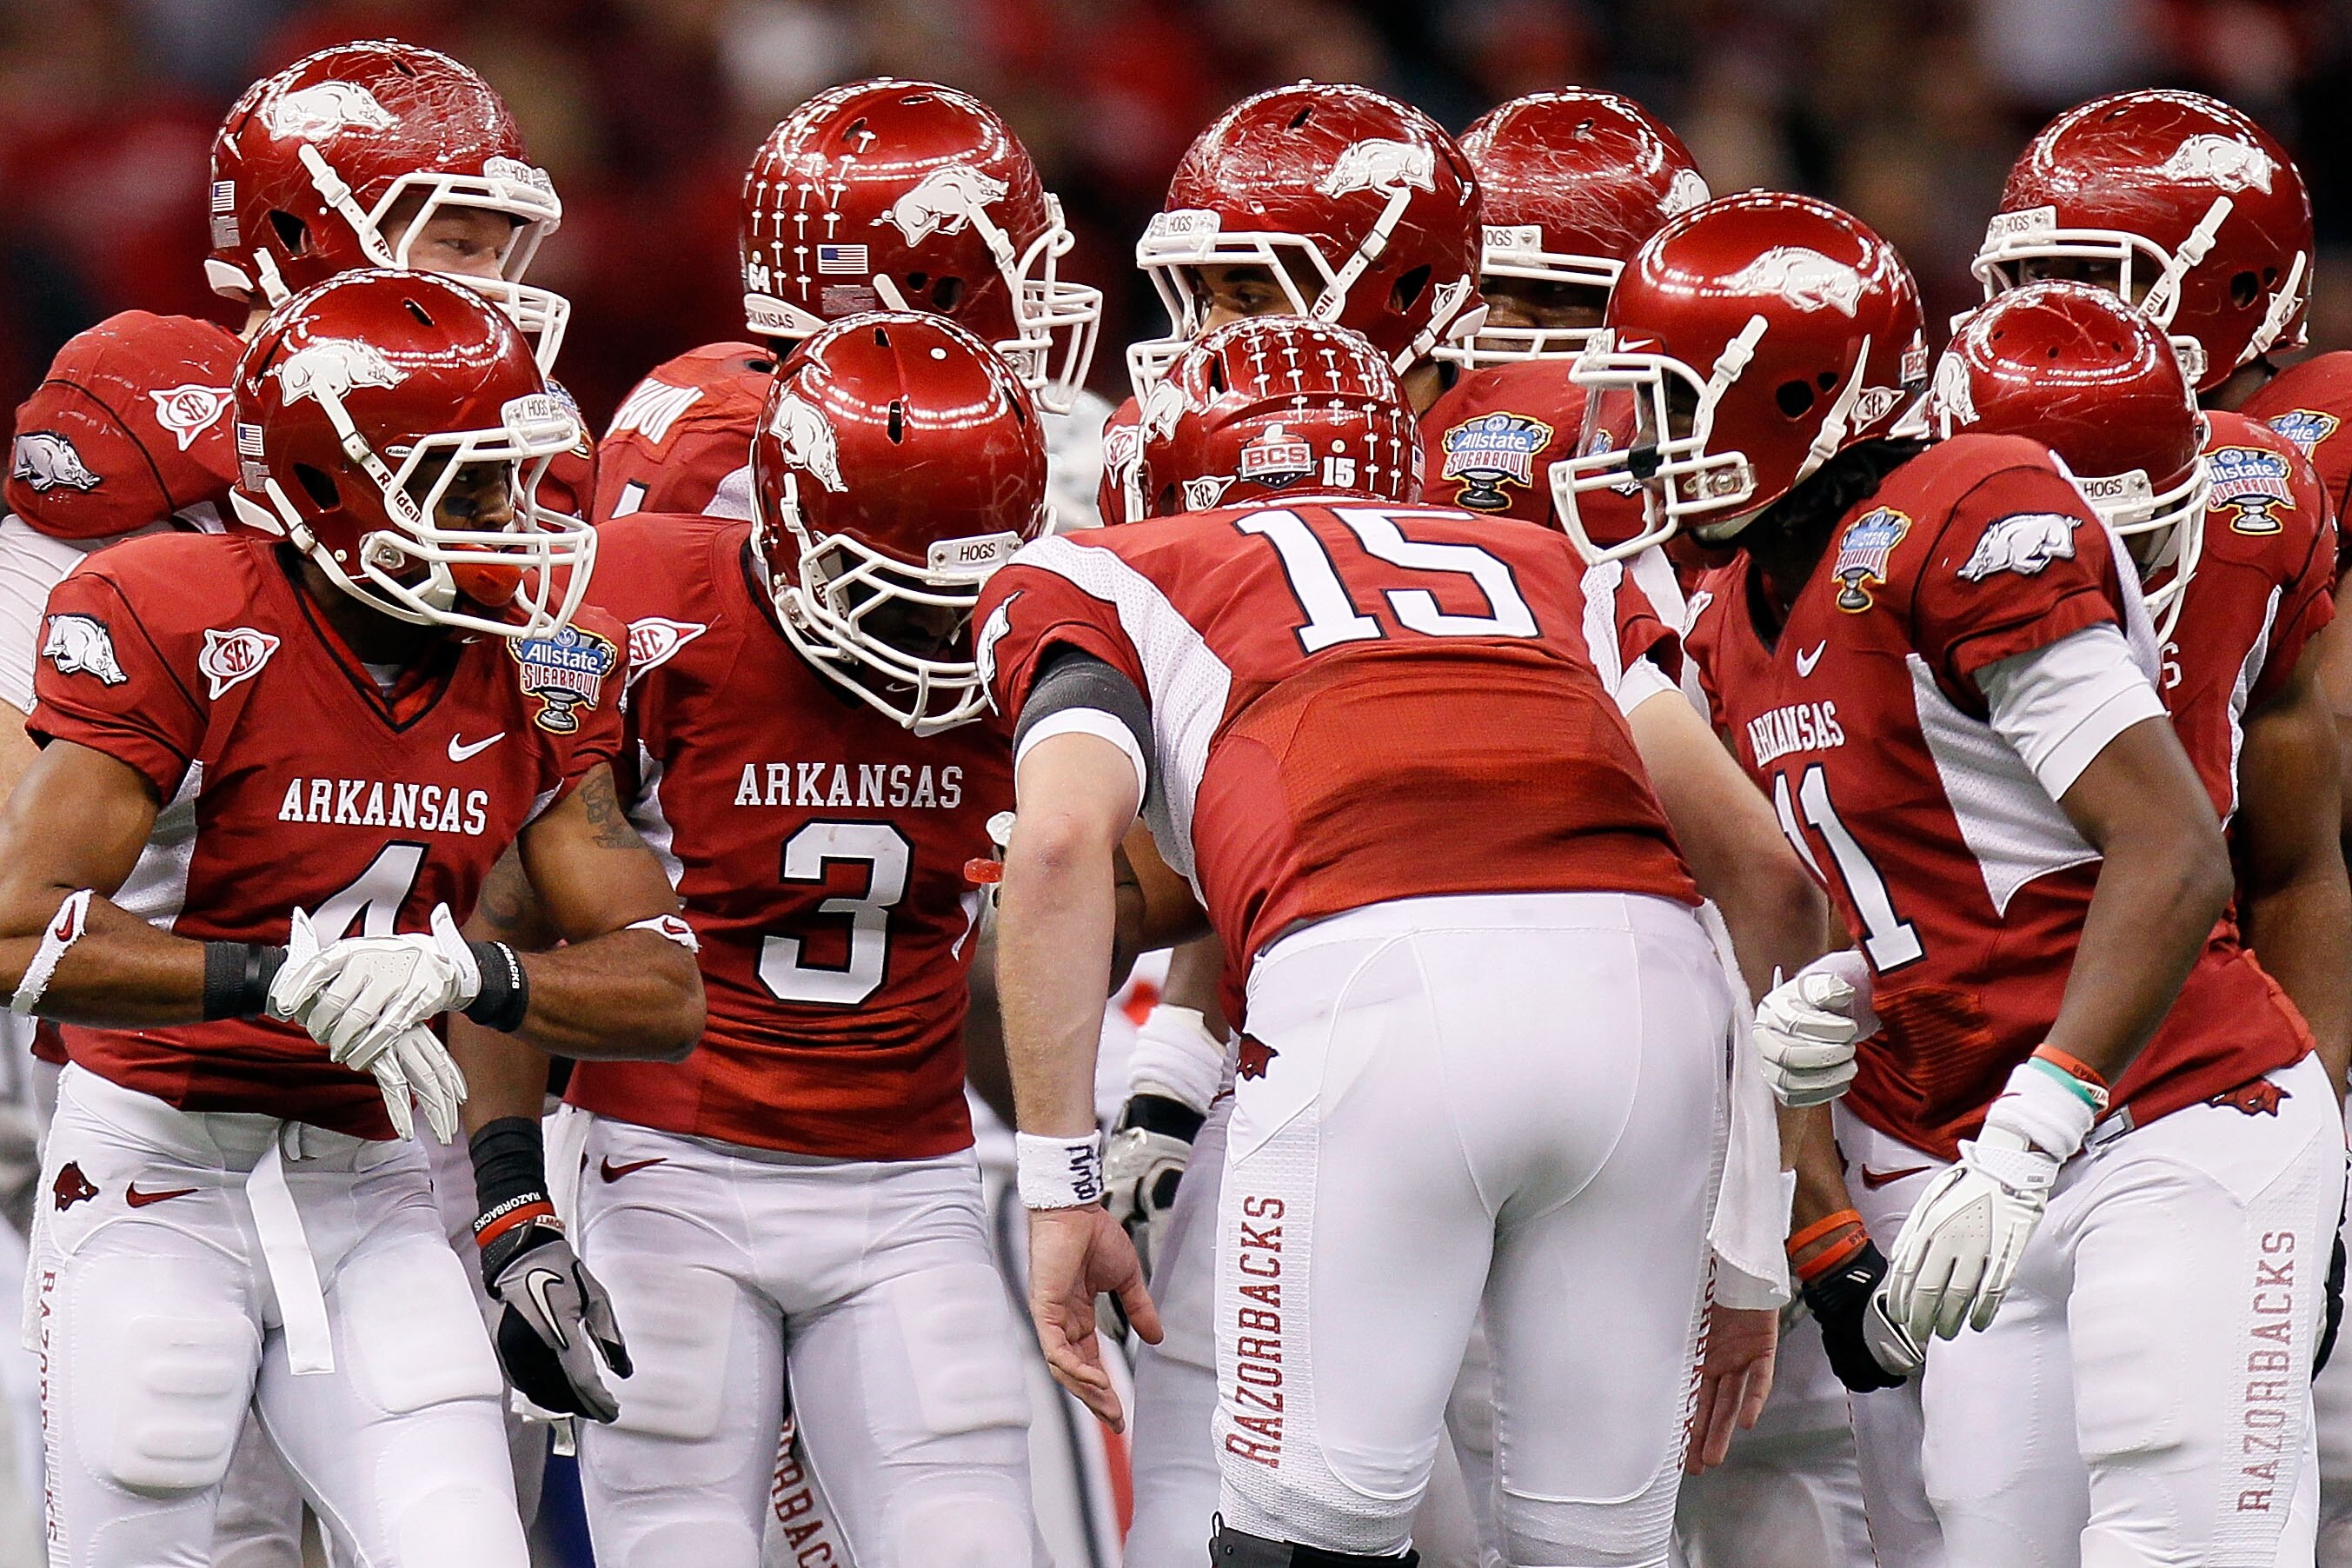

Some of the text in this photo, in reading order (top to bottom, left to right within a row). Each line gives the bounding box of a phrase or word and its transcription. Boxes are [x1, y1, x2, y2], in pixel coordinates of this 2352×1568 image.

[1485, 229, 1512, 246] OGS
[2007, 215, 2030, 232] OGS
[176, 394, 209, 422] SEC
[528, 397, 549, 417] HOGS
[1865, 393, 1884, 416] SEC
[1246, 446, 1309, 467] BCS
[1322, 456, 1356, 488] 15
[1194, 482, 1213, 507] SEC
[2084, 478, 2123, 497] HOGS
[959, 542, 997, 561] HOGS
[1232, 506, 1545, 655] 15
[223, 638, 254, 672] SEC
[629, 628, 663, 661] SEC
[1746, 700, 1845, 768] ARKANSAS
[734, 761, 963, 809] ARKANSAS
[278, 777, 489, 836] ARKANSAS
[1773, 761, 1927, 978] 11
[308, 840, 430, 947] 4
[755, 817, 916, 1007] 3
[474, 1192, 541, 1232] RAZORBACKS
[1226, 1194, 1286, 1469] RAZORBACKS
[2236, 1229, 2296, 1513] RAZORBACKS
